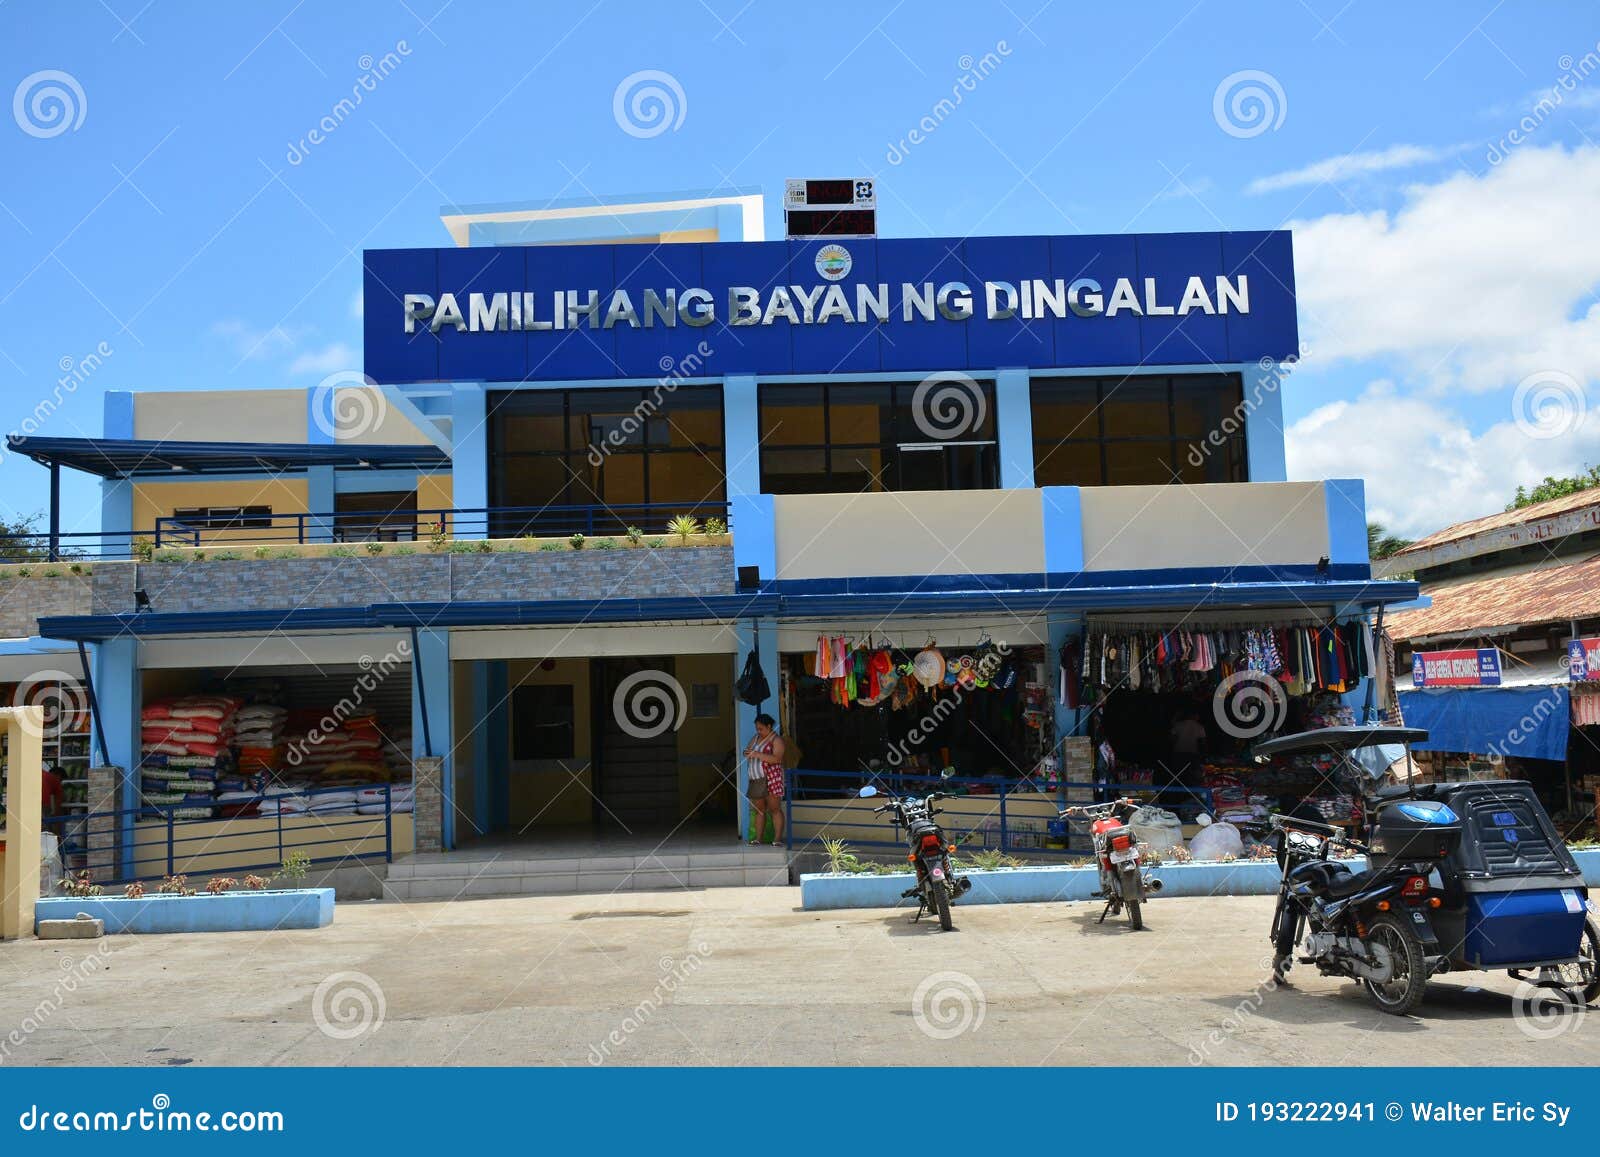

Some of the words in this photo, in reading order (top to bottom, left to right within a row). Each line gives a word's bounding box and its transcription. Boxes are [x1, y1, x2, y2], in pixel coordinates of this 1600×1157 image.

[404, 287, 715, 334] PAMILIHANG
[728, 283, 889, 328] BAYAN
[902, 281, 974, 323] NG
[985, 274, 1250, 320] DINGALAN
